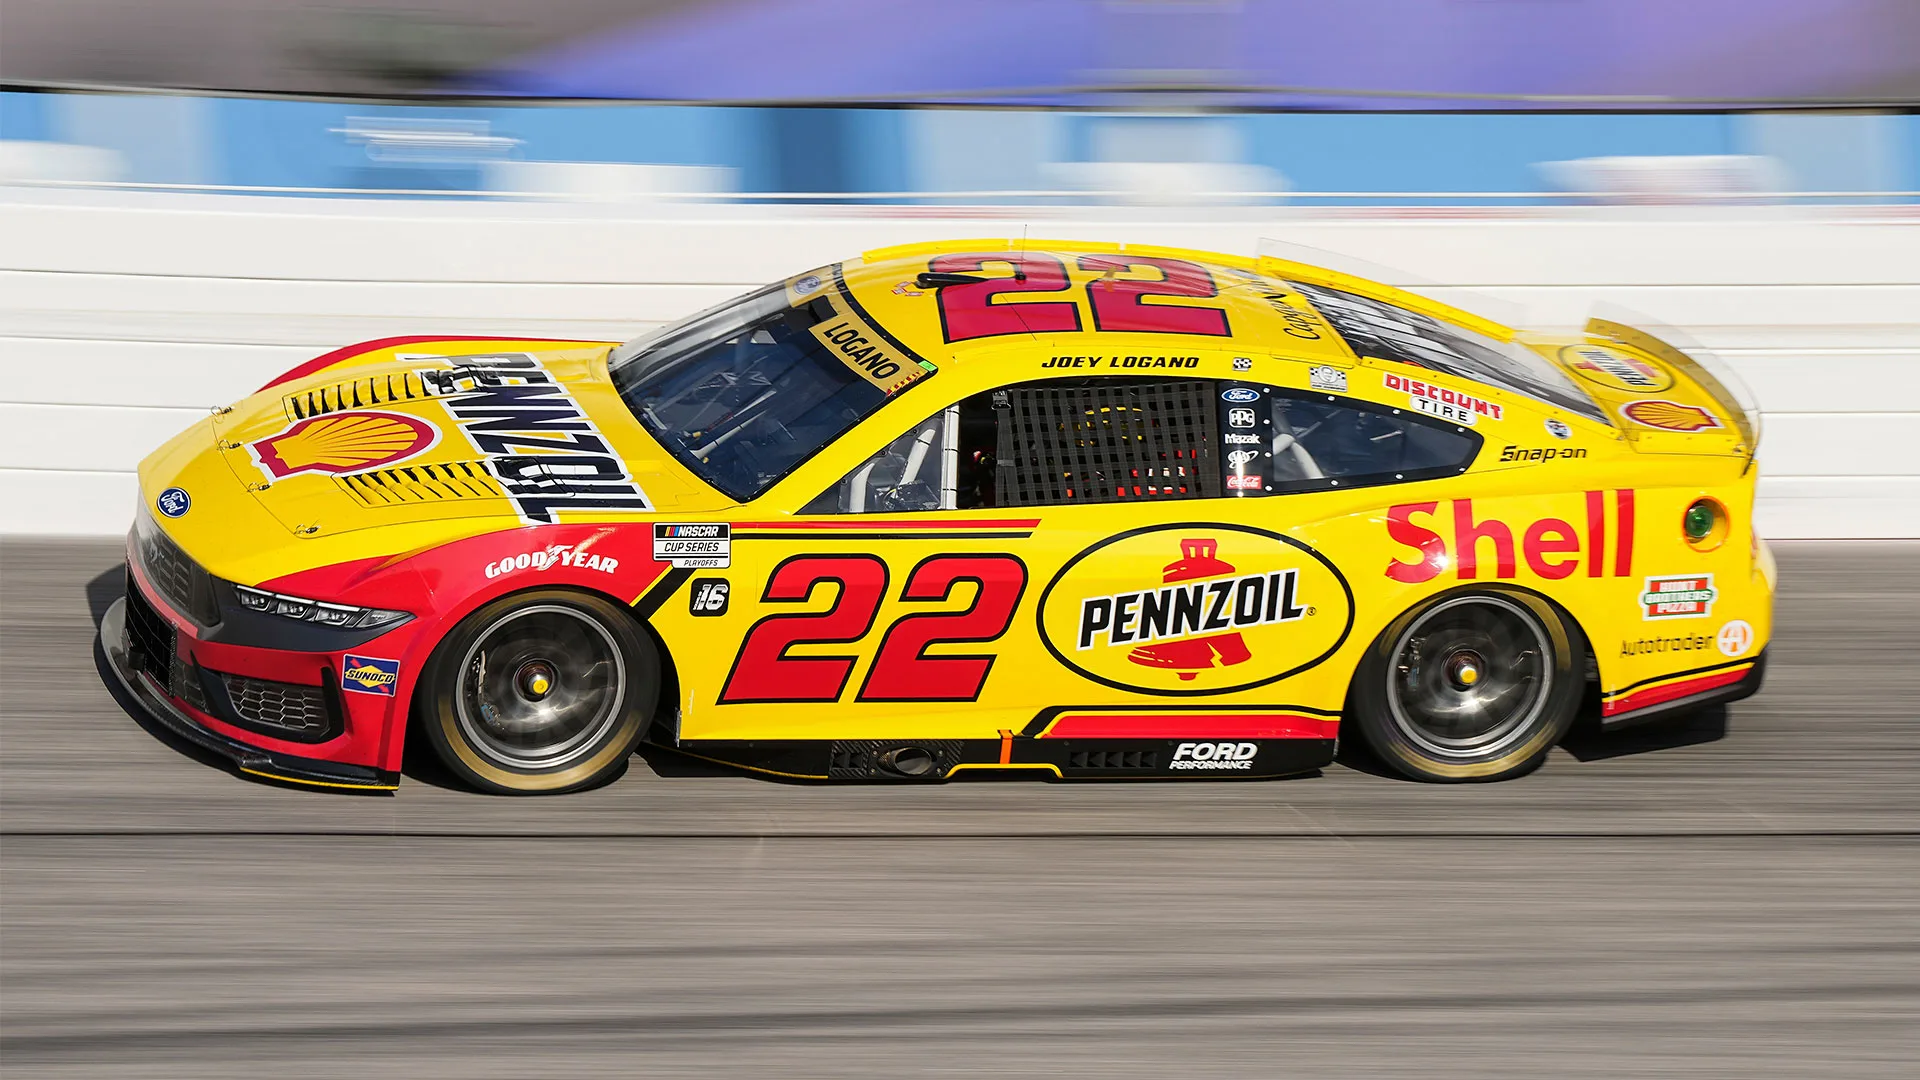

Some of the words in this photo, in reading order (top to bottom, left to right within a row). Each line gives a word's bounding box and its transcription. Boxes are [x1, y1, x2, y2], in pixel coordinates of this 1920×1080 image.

[928, 251, 1232, 344] 22
[823, 322, 900, 379] LOGANO
[1041, 356, 1103, 368] JOEY
[1109, 356, 1200, 368] LOGANO
[1385, 373, 1501, 419] DISCOUNT
[1231, 409, 1254, 425] PPG
[1418, 398, 1467, 421] TIRE
[1225, 433, 1260, 444] Mazak
[1499, 445, 1587, 463] Snap-on
[160, 491, 185, 514] Ford
[677, 526, 719, 537] NASCAR
[1384, 489, 1634, 583] Shell
[664, 542, 684, 552] CUP
[685, 542, 719, 552] SERIES
[683, 559, 718, 567] PLAYOFFS
[694, 584, 729, 610] 16
[1079, 570, 1304, 649] PENNZOIL
[716, 553, 1028, 705] 22
[1620, 633, 1714, 658] Autotrader
[346, 670, 394, 683] SUNOCO
[1173, 742, 1258, 760] FORD
[1169, 761, 1253, 769] PERFORMANCE
